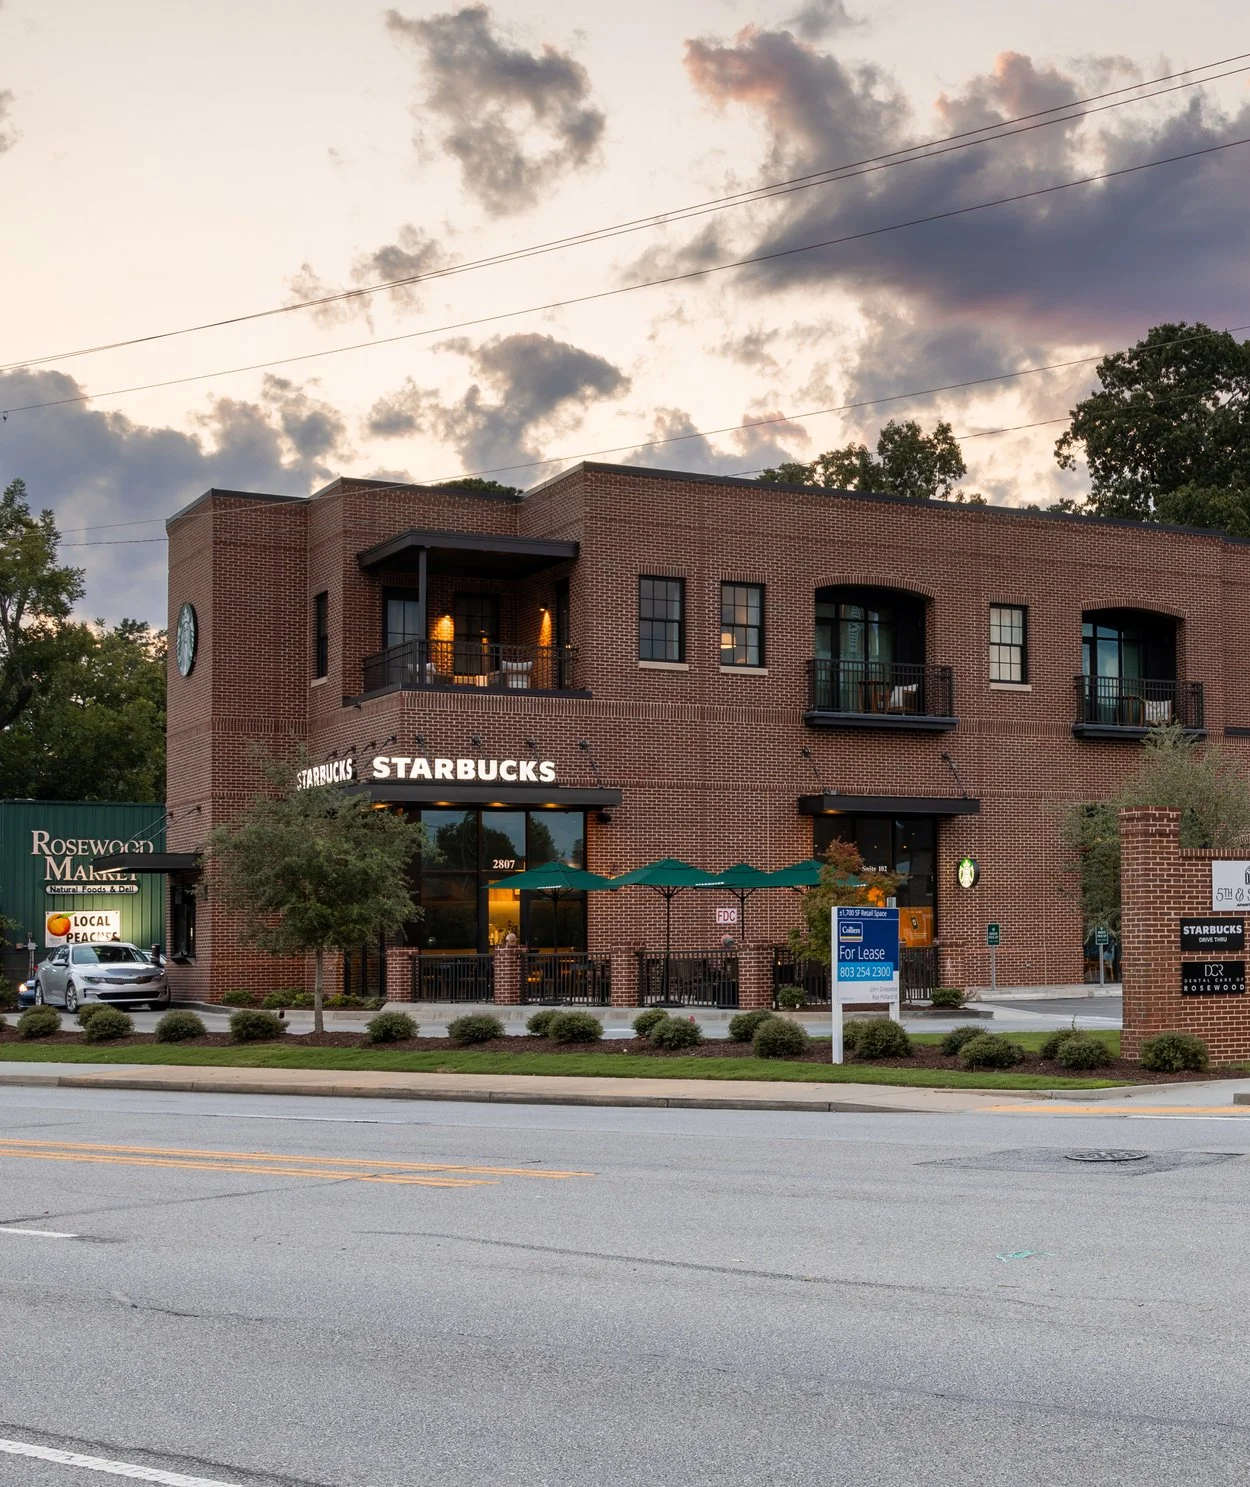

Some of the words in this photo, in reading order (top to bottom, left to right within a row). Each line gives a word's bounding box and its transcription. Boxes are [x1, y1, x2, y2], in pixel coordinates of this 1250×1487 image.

[297, 758, 353, 791] STARBUCKS
[372, 756, 556, 782] STARBUCKS
[31, 830, 154, 856] ROSEWOOD
[493, 860, 515, 869] 2807
[1216, 888, 1233, 901] 5TH
[1235, 888, 1244, 901] &
[717, 911, 735, 921] FDC
[874, 910, 887, 918] Space
[73, 915, 110, 927] LOCAL
[842, 926, 861, 934] Colliers
[1183, 925, 1242, 935] STARBUCKS
[840, 946, 856, 960] For
[858, 946, 885, 960] Lease
[840, 967, 855, 977] 803
[856, 967, 870, 977] 254
[872, 966, 890, 977] 2300
[1204, 964, 1223, 977] DCR
